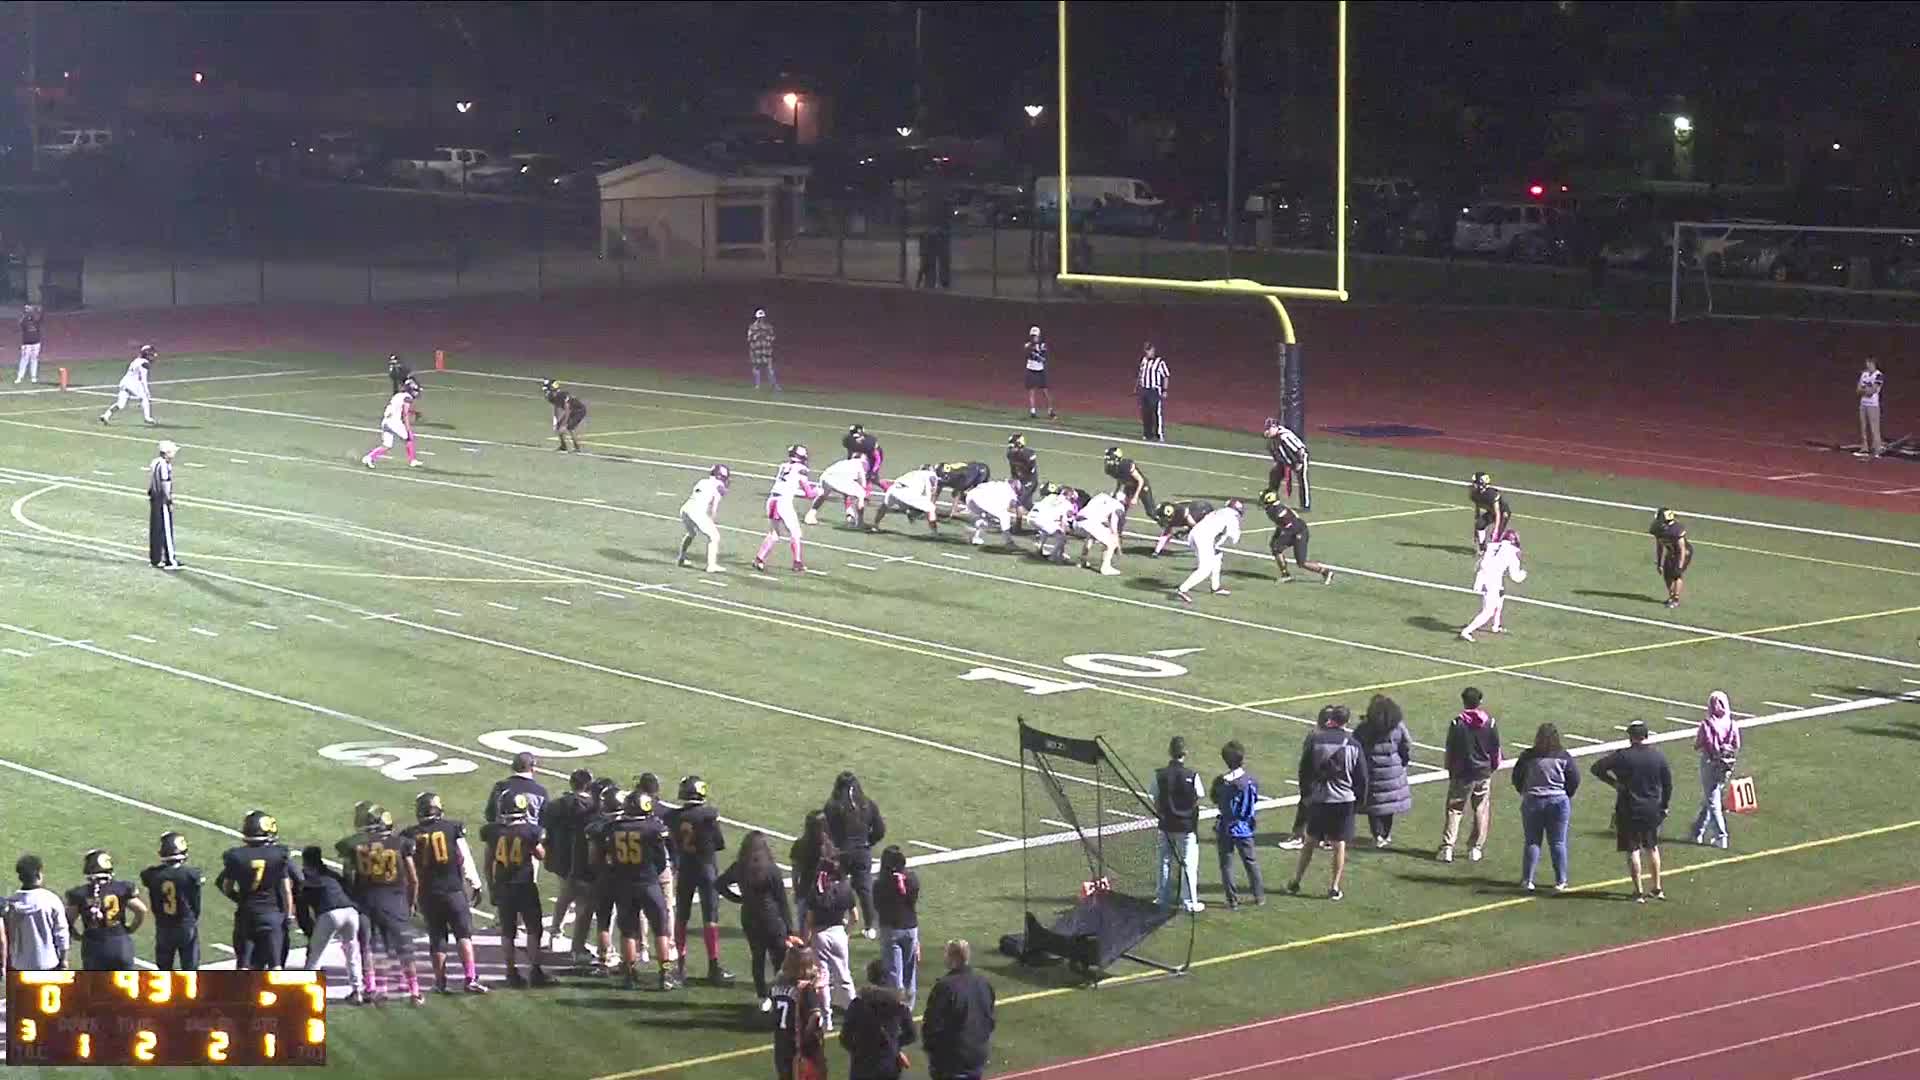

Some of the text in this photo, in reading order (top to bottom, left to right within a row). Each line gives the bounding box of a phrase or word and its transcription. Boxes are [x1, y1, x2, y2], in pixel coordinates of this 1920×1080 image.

[957, 653, 1189, 695] 10
[318, 729, 608, 781] 20
[1736, 782, 1754, 807] 10
[415, 831, 448, 864] 70
[496, 835, 522, 866] 44
[614, 832, 641, 864] 55
[251, 859, 266, 890] 7
[777, 1000, 788, 1029] 7
